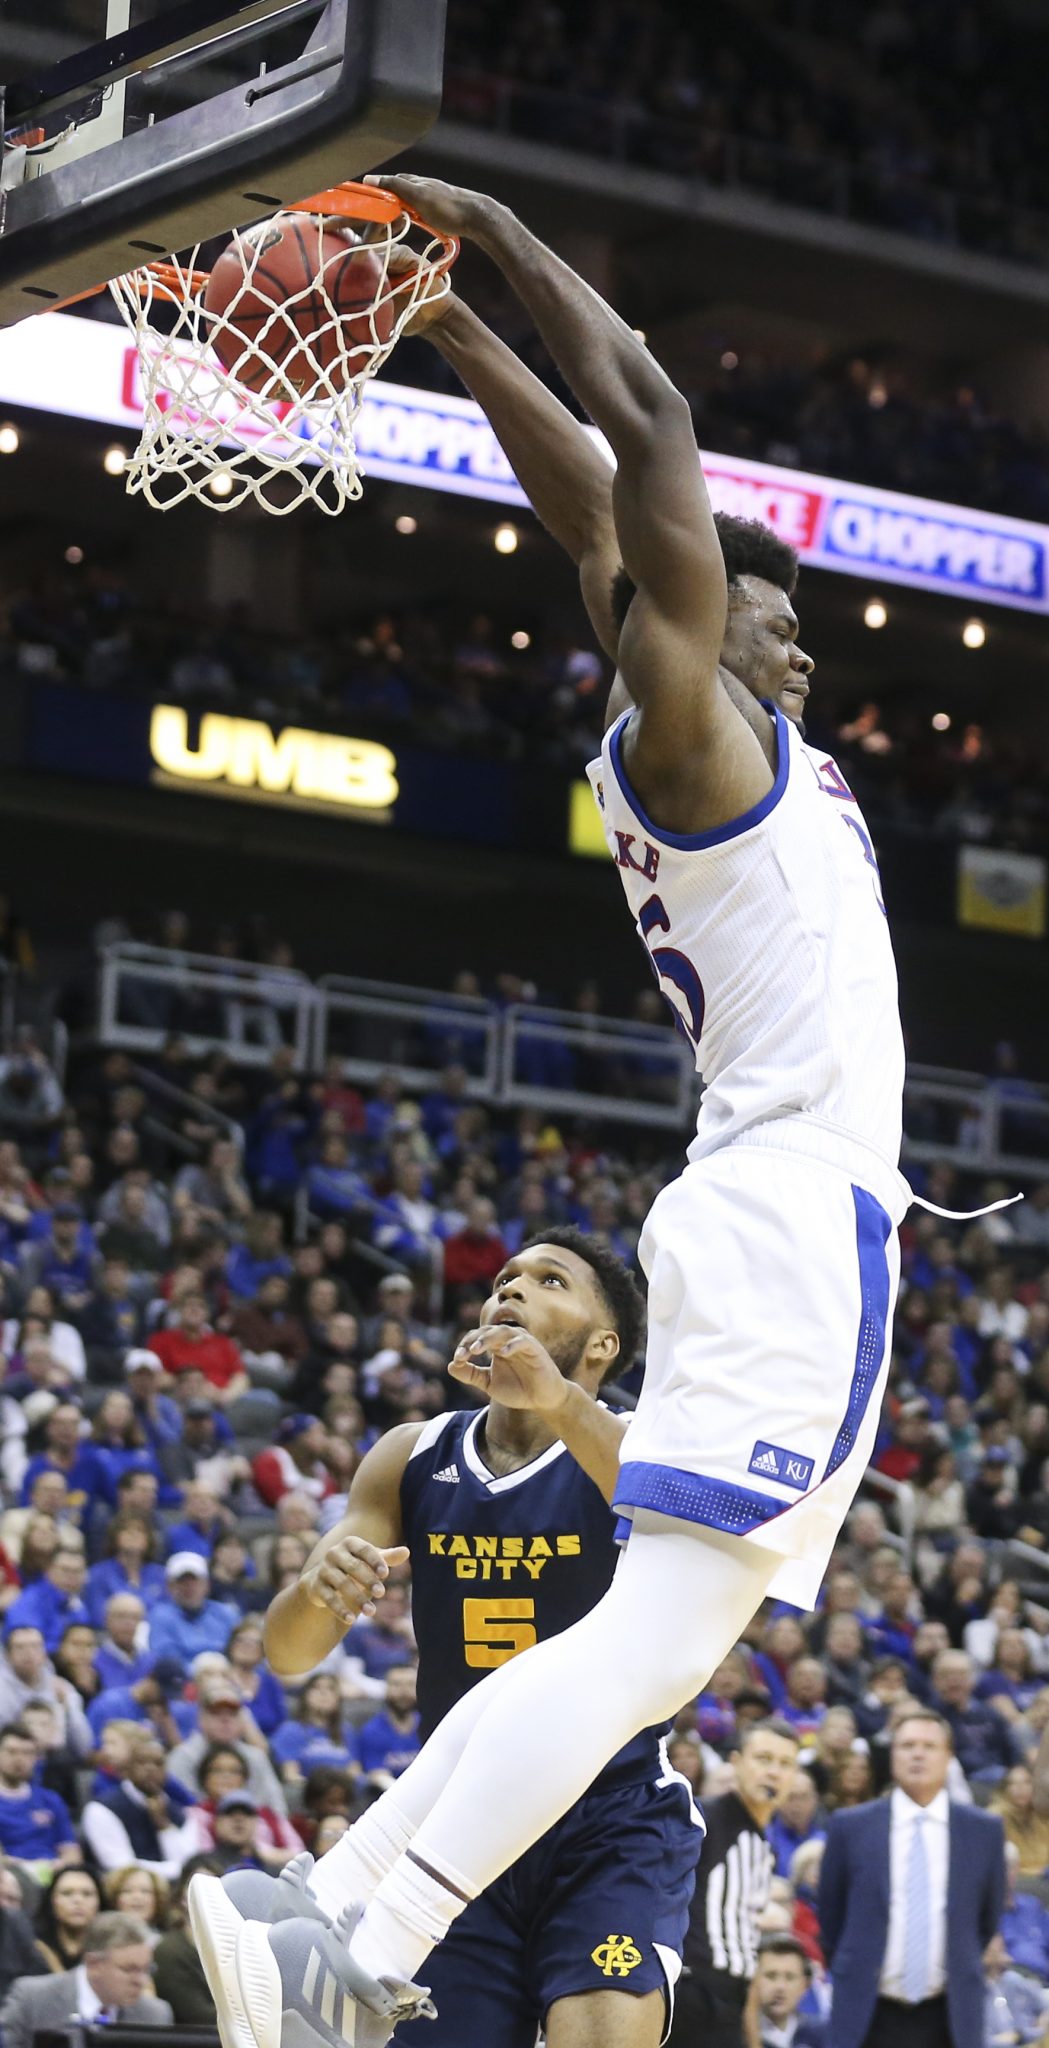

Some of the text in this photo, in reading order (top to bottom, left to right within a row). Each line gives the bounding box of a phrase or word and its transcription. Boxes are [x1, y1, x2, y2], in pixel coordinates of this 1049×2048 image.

[830, 502, 1036, 593] CHOPPER
[150, 703, 399, 808] UMB
[785, 1459, 809, 1481] KU
[427, 1533, 581, 1558] KANSAS
[456, 1558, 547, 1580] CITY
[463, 1597, 538, 1669] 5
